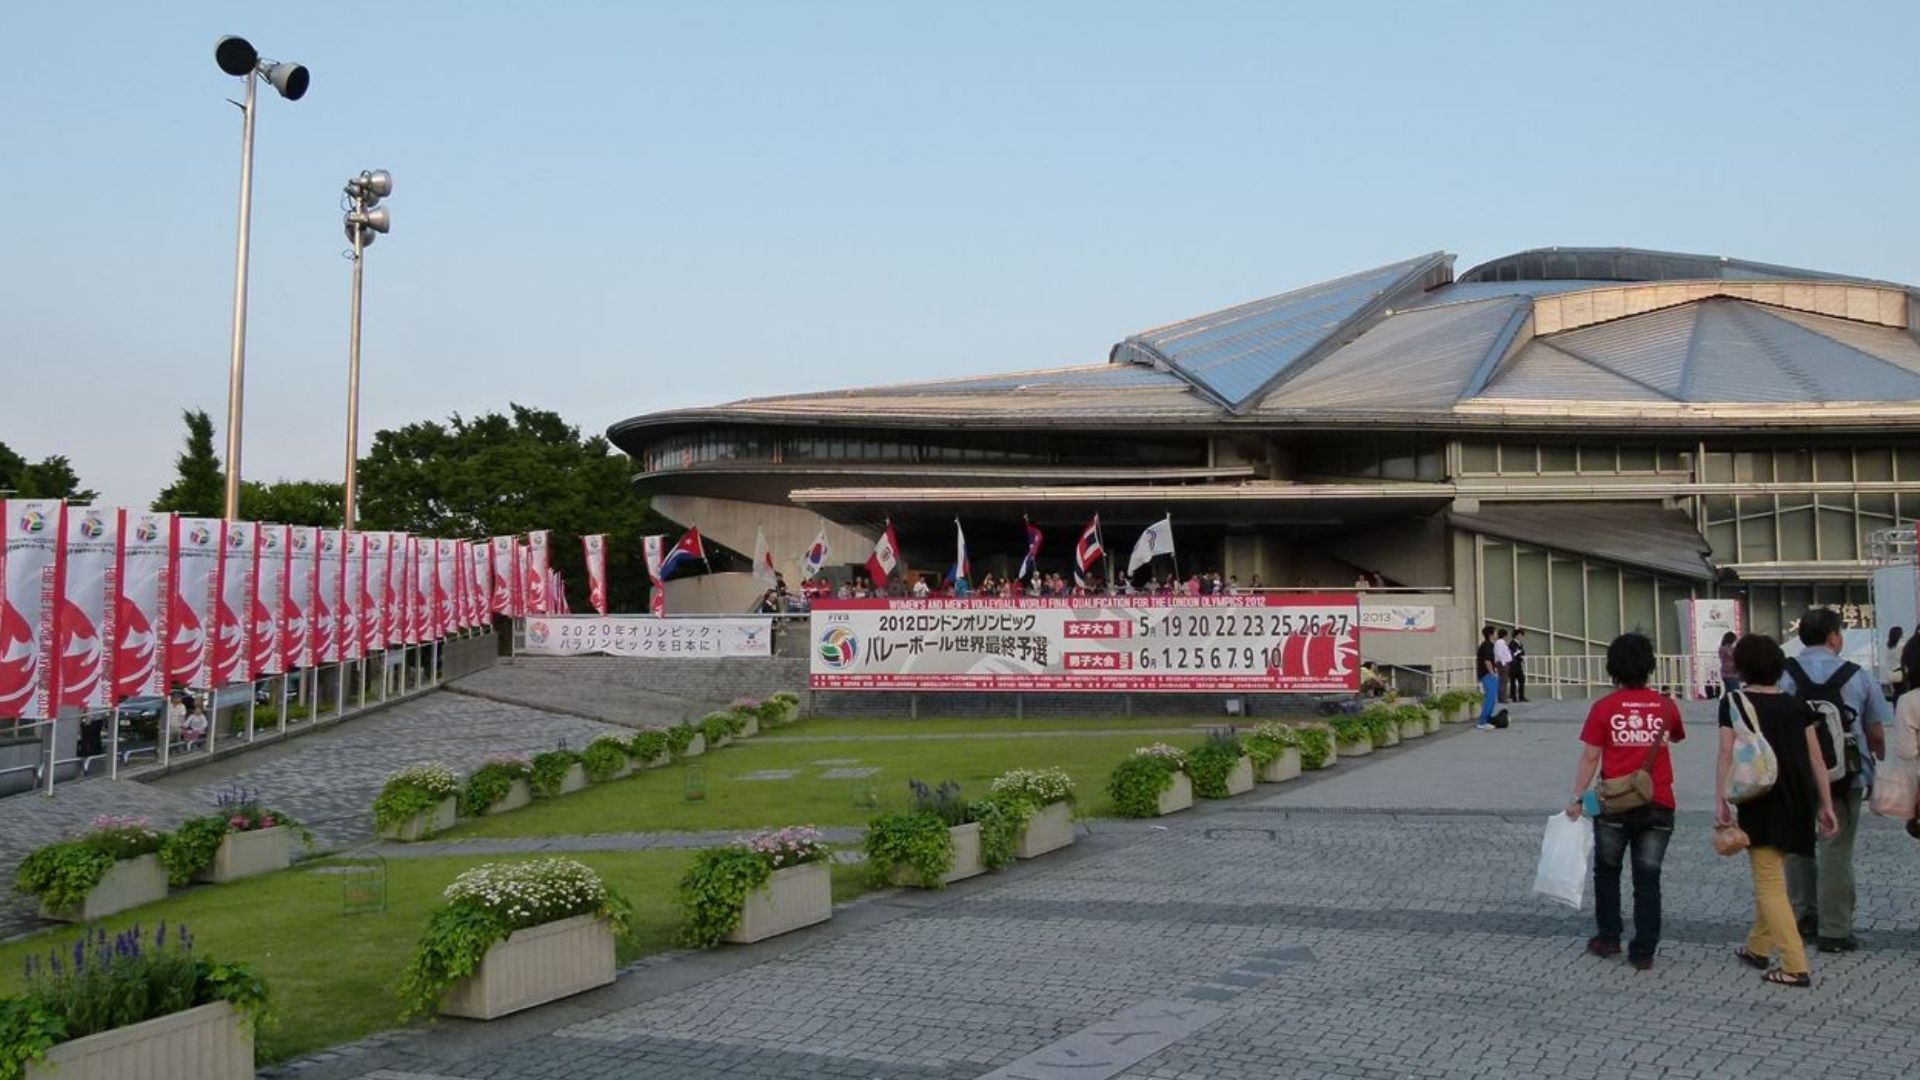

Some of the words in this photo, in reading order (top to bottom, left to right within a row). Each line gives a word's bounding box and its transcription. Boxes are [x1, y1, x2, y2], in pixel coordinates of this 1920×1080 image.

[889, 599, 926, 609] WOMEN'S
[928, 599, 943, 609] AND
[945, 599, 969, 609] MEN'S
[971, 599, 1016, 609] VOLLEYBALL
[1018, 599, 1048, 609] WORLD
[1049, 598, 1070, 608] FINAL
[1072, 598, 1131, 608] QUALIFICATION
[1132, 597, 1149, 608] FOR
[1150, 597, 1167, 608] THE
[1168, 597, 1200, 607] LONDON
[1201, 597, 1243, 607] OLYMPICS
[1244, 596, 1266, 606] 2012
[879, 615, 1035, 631] 2012ロンドンオリンピック
[1362, 612, 1392, 623] 2013
[1068, 623, 1114, 635] 女子大会
[1162, 615, 1182, 637] 19
[1188, 615, 1210, 637] 20
[1216, 615, 1236, 637] 22
[1243, 615, 1264, 637] 23
[1271, 615, 1292, 637] 25
[1299, 615, 1320, 637] 26
[1327, 615, 1348, 637] 27
[865, 636, 1049, 667] バレーボール世界最終予選
[1177, 647, 1188, 668] 2
[1261, 647, 1282, 668] 10
[1068, 655, 1114, 668] 男子大会
[1647, 714, 1664, 730] fo
